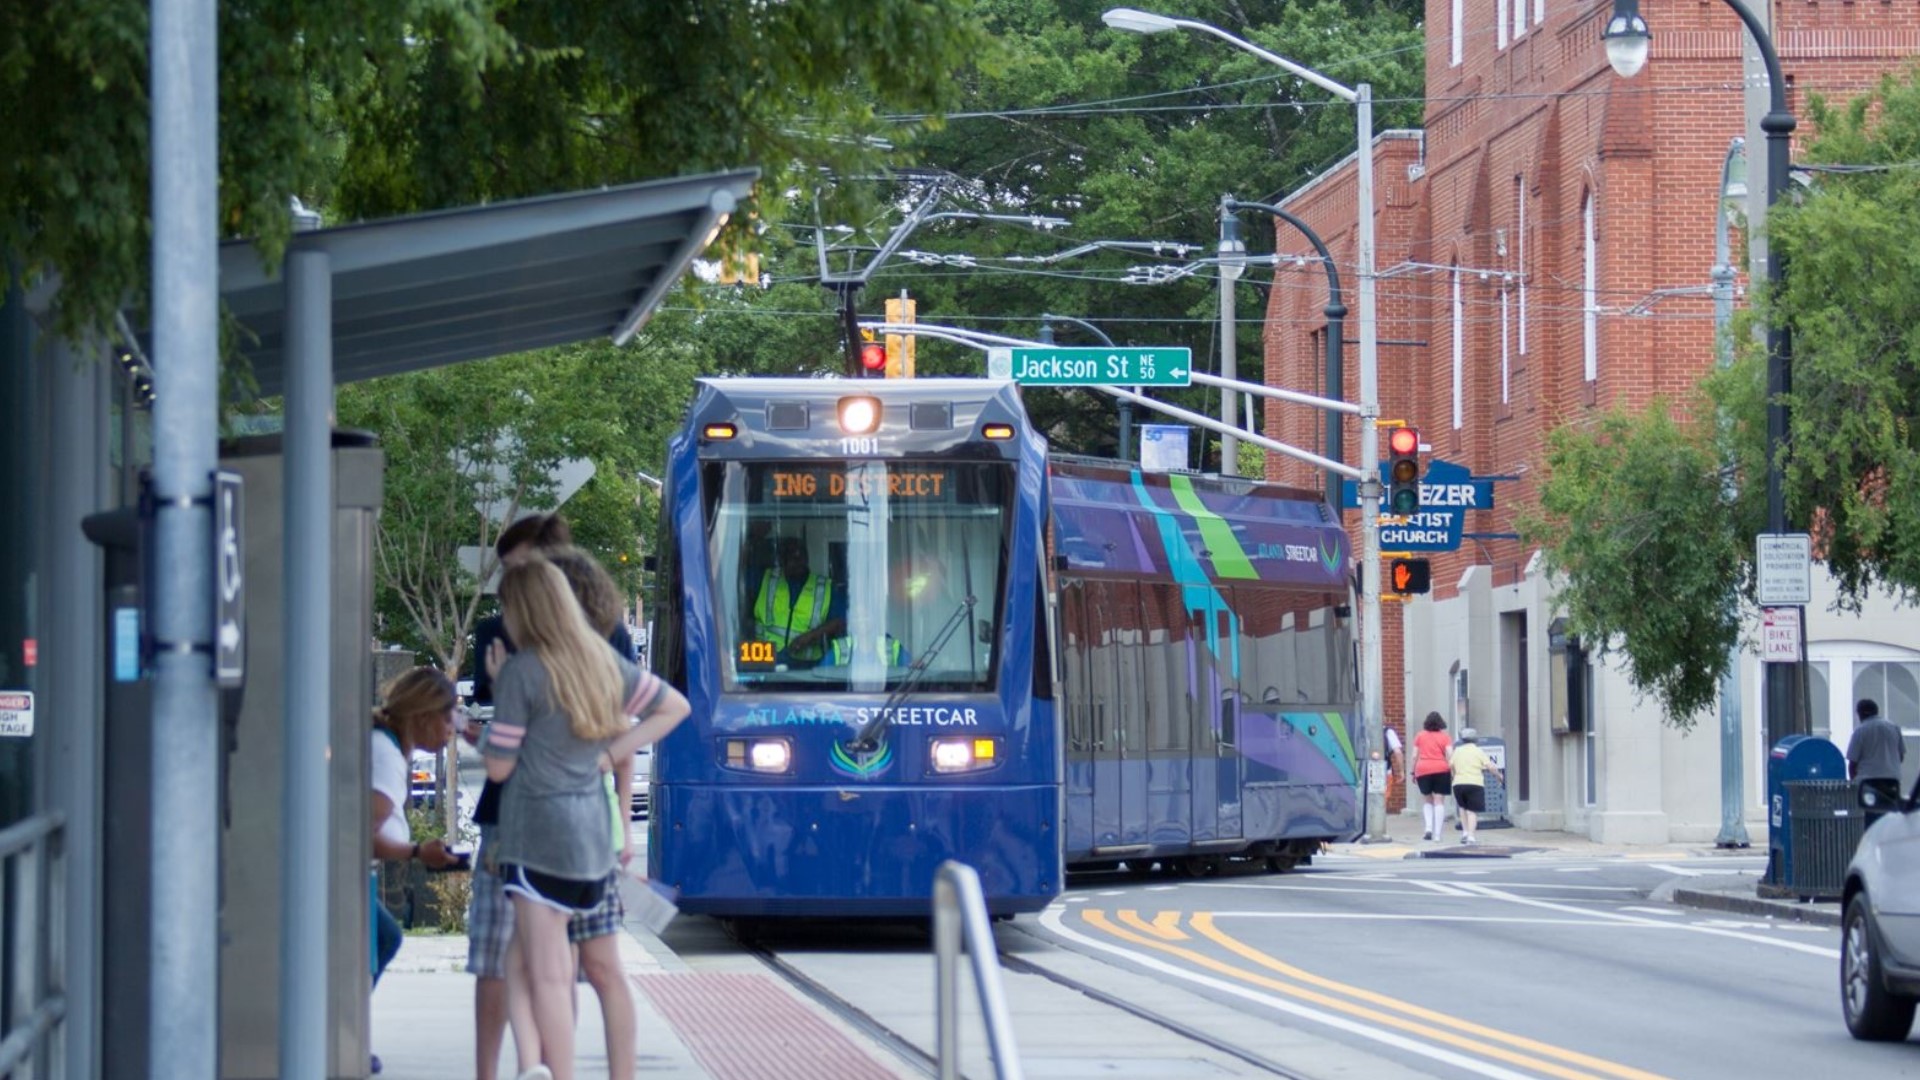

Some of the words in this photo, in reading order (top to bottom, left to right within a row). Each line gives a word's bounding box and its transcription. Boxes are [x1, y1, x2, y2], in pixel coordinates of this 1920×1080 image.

[1015, 355, 1097, 378] Jackson
[1106, 354, 1129, 378] St
[1140, 354, 1155, 366] NE
[1140, 367, 1155, 379] 50
[841, 438, 879, 455] 1001
[773, 473, 816, 496] ING
[830, 473, 944, 496] DISTRICT
[1381, 530, 1448, 543] CHURCH
[1285, 544, 1318, 562] STREETCAR
[1769, 630, 1792, 640] BIKE
[740, 642, 774, 662] 101
[1769, 643, 1794, 653] LANE
[746, 708, 844, 725] ATLANTA
[857, 707, 978, 725] STREETCAR
